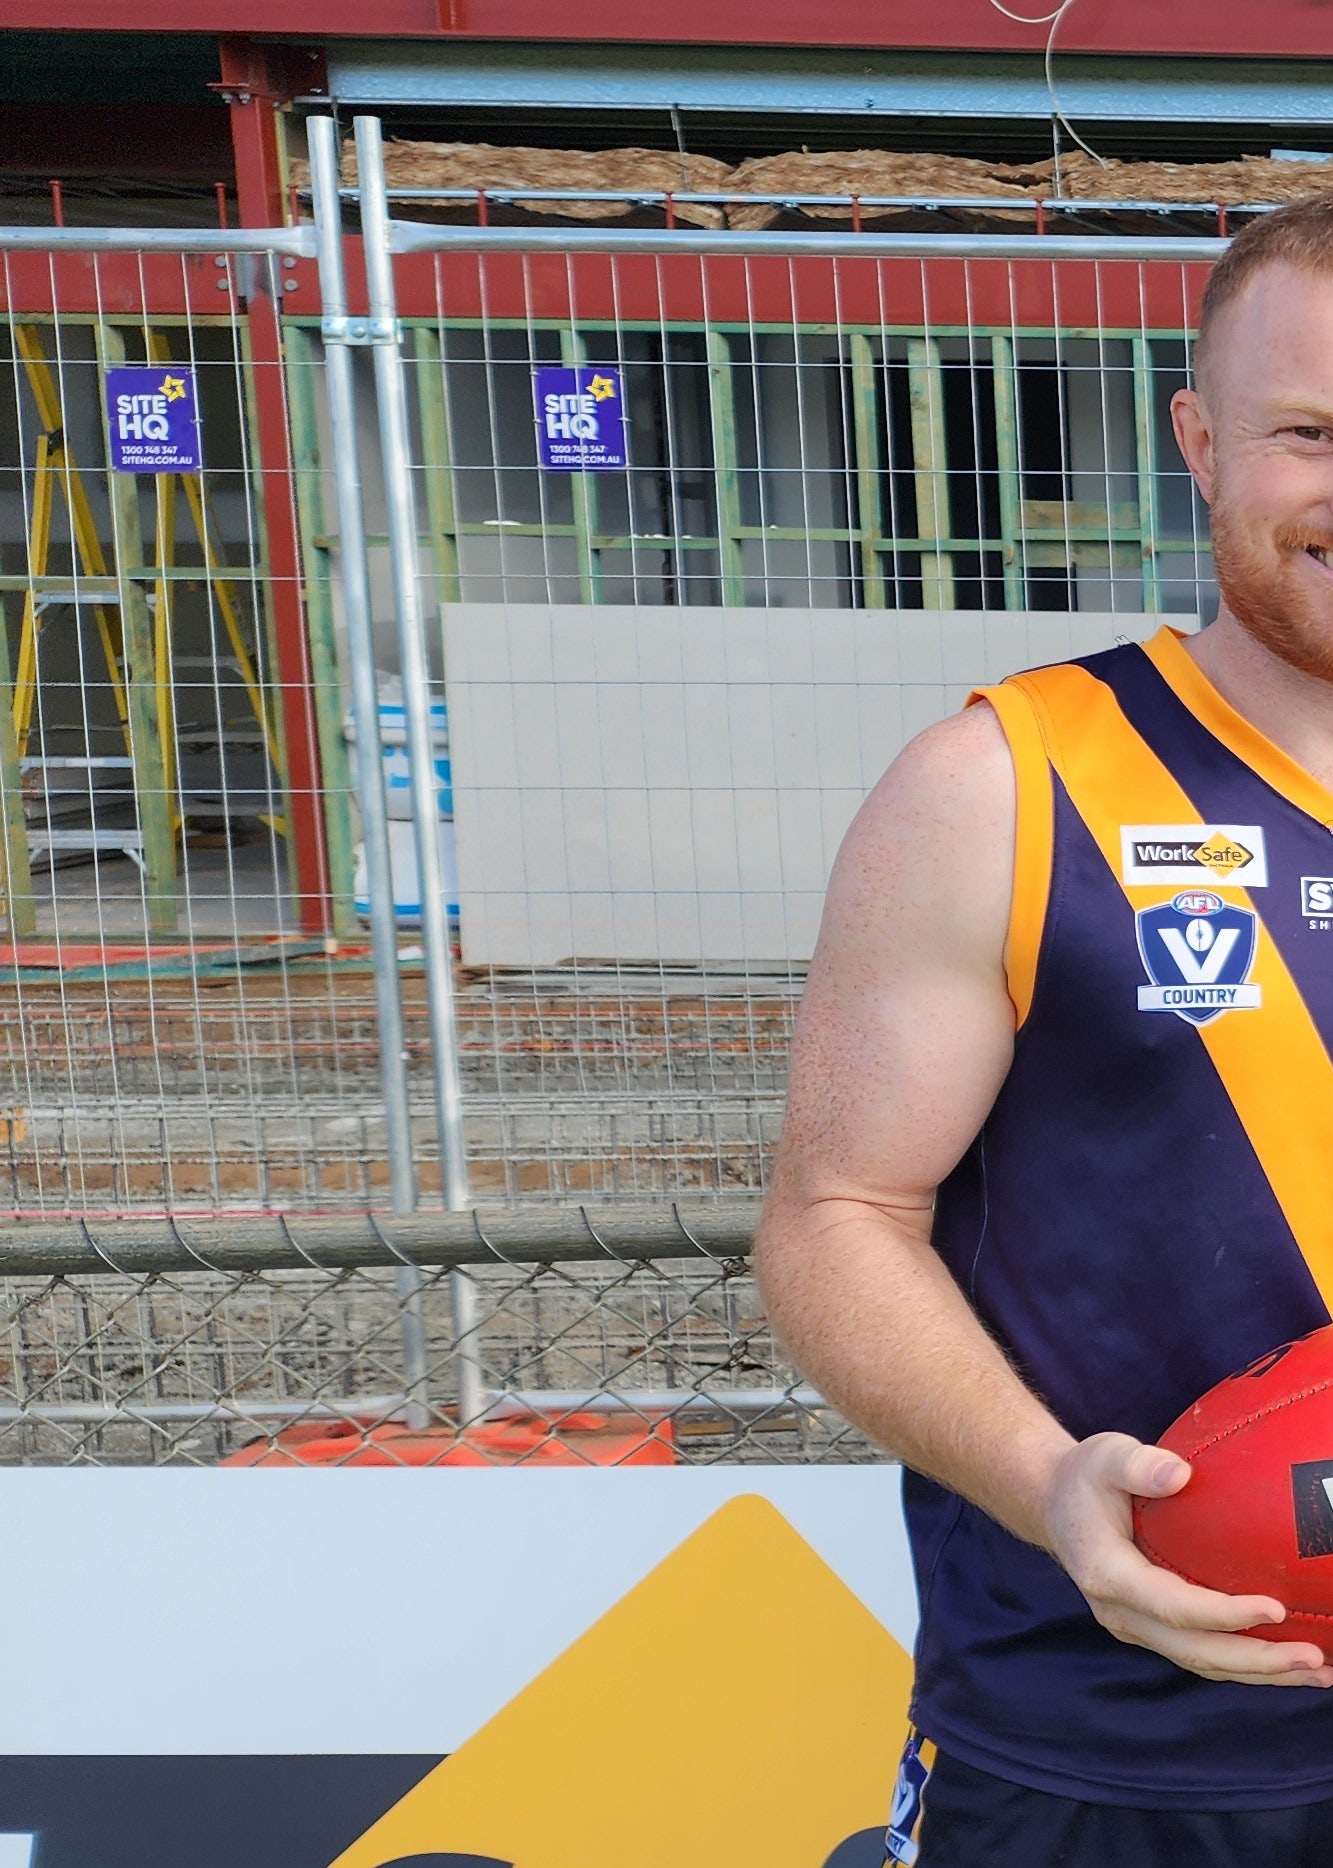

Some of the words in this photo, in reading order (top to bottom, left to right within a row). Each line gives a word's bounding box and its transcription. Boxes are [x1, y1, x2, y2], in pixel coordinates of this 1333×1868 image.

[117, 394, 167, 414] SITE
[544, 394, 597, 414] SITE
[118, 414, 169, 440] HQ
[545, 413, 599, 440] HQ
[121, 446, 143, 454] 1300
[121, 456, 193, 465] SITEHQ.COM.AU
[550, 455, 620, 464] SITEHQCOM.AU
[1175, 896, 1221, 910] AFL
[1163, 989, 1237, 1005] COUNTRY
